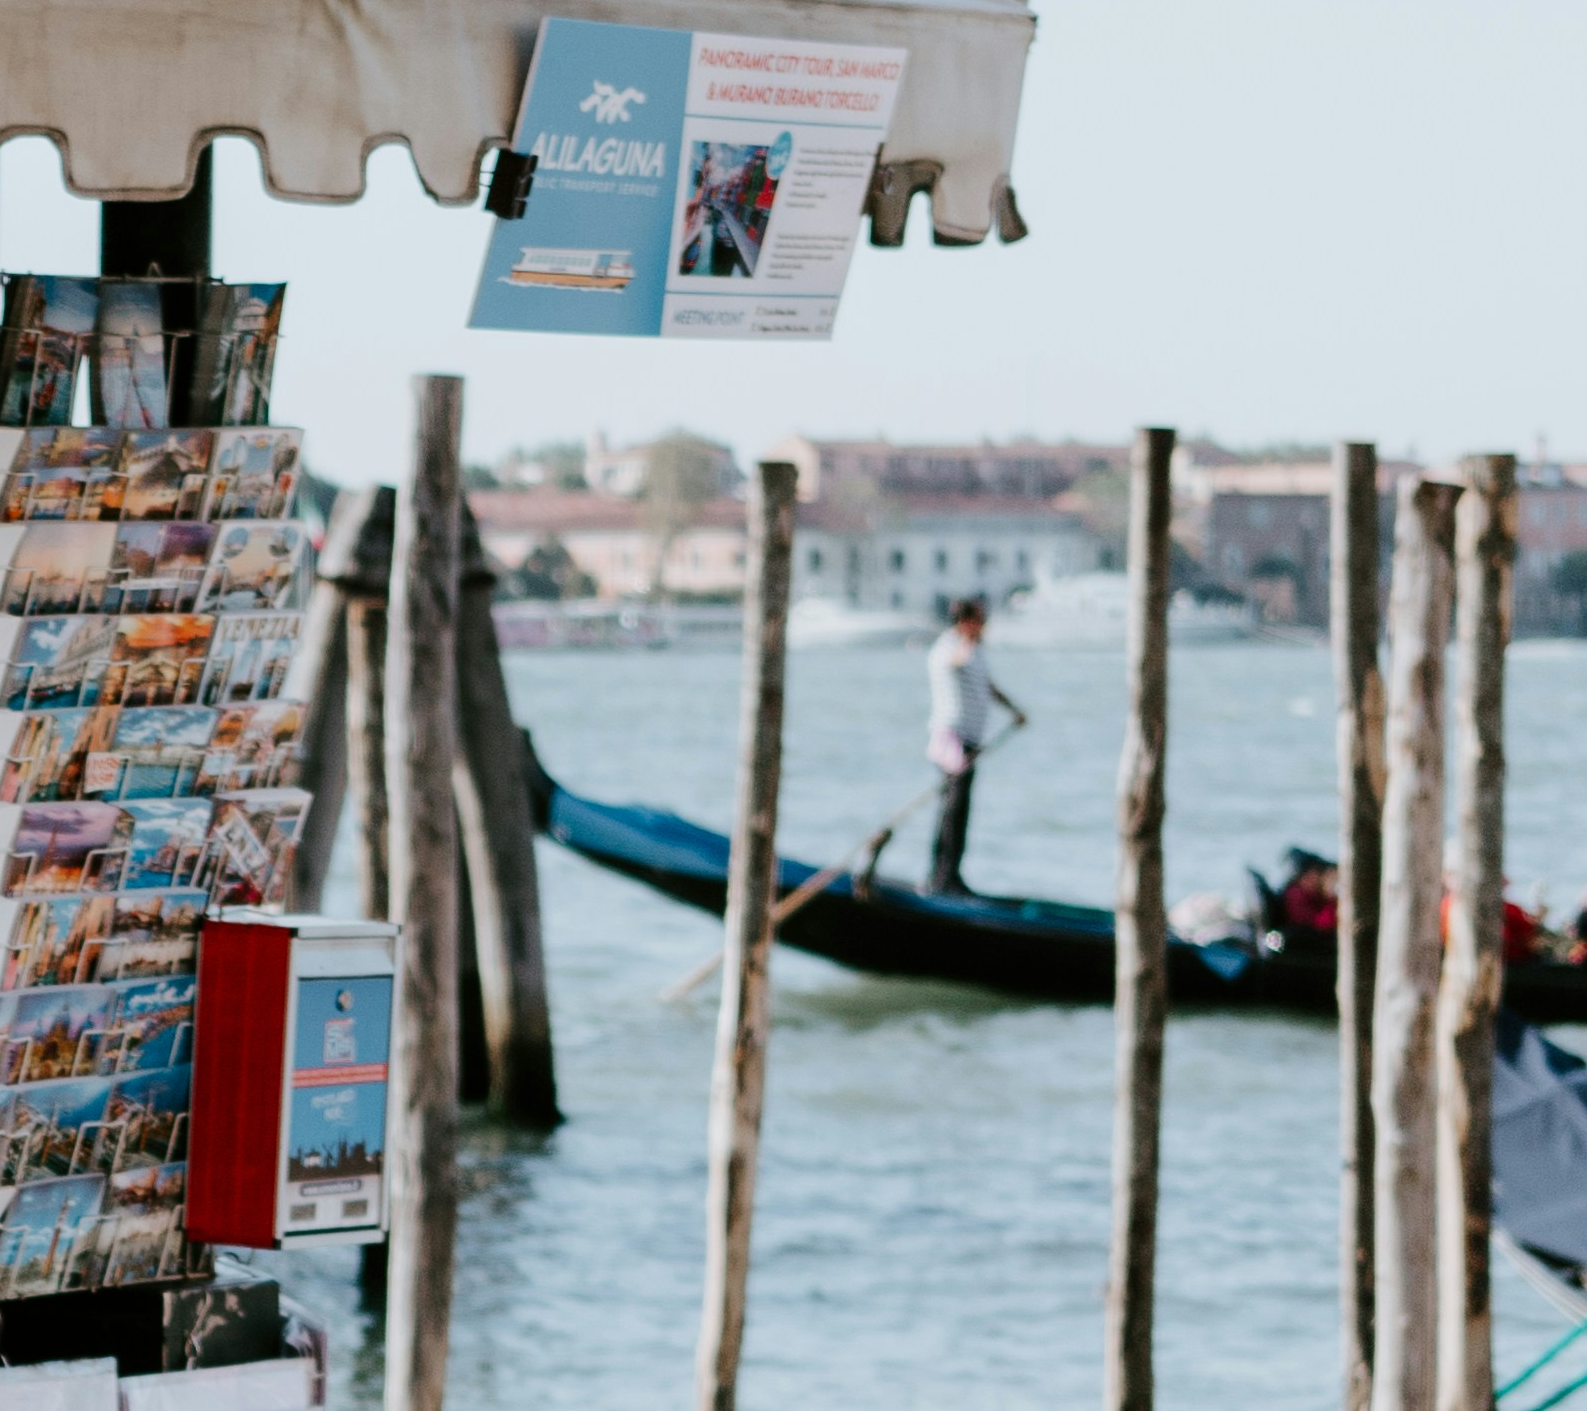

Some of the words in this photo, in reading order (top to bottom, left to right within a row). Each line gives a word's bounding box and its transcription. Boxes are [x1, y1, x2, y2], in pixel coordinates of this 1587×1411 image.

[699, 48, 773, 74] PANORAMIC
[777, 54, 801, 75] CITY
[533, 131, 665, 178] ALILAGUNA
[221, 617, 301, 638] VENEZIA
